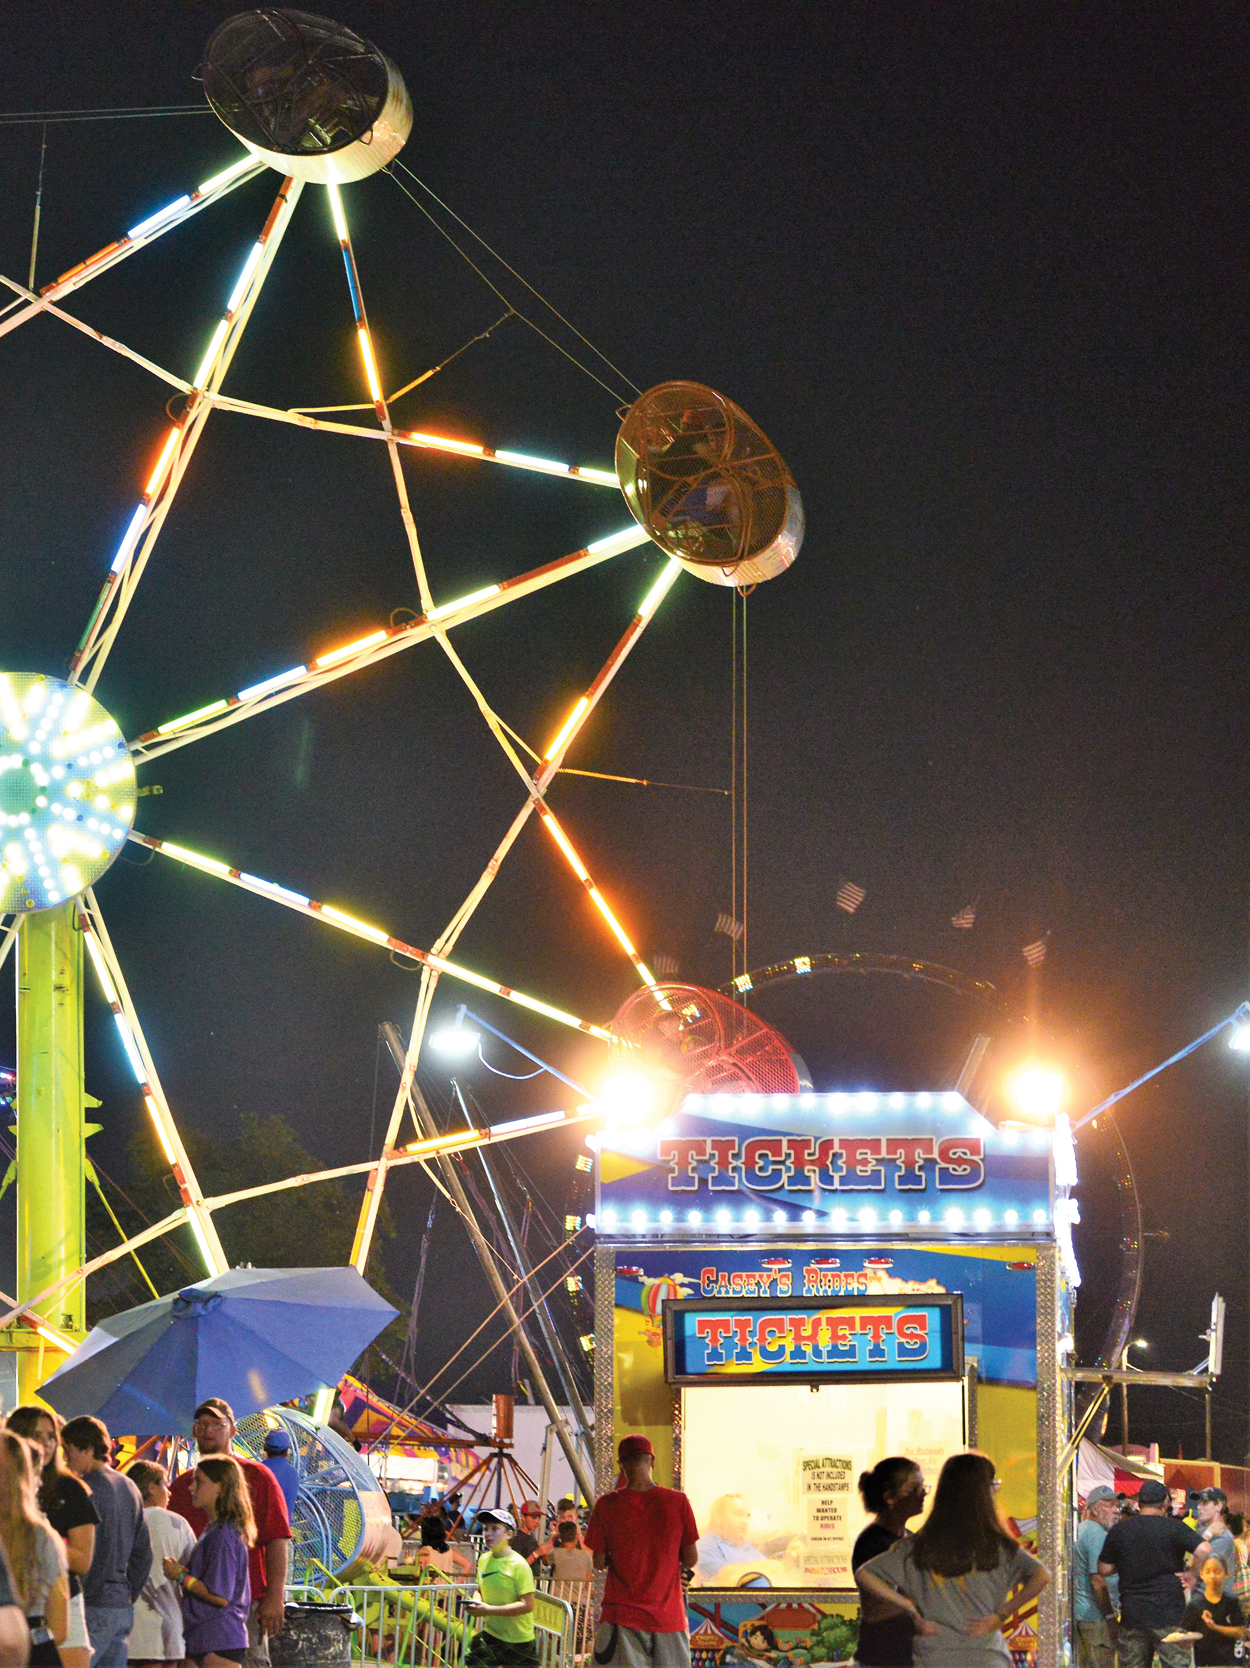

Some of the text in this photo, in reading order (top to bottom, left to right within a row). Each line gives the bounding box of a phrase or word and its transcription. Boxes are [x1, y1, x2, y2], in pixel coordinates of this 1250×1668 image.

[657, 1136, 985, 1191] TICKETS
[696, 1313, 930, 1365] TICKETS
[802, 1457, 852, 1471] SPECIAL ATTRACTIONS
[816, 1471, 825, 1480] NOT
[826, 1471, 846, 1480] INCLUDED
[813, 1482, 821, 1492] THE
[822, 1482, 849, 1492] HANDSTAMPS
